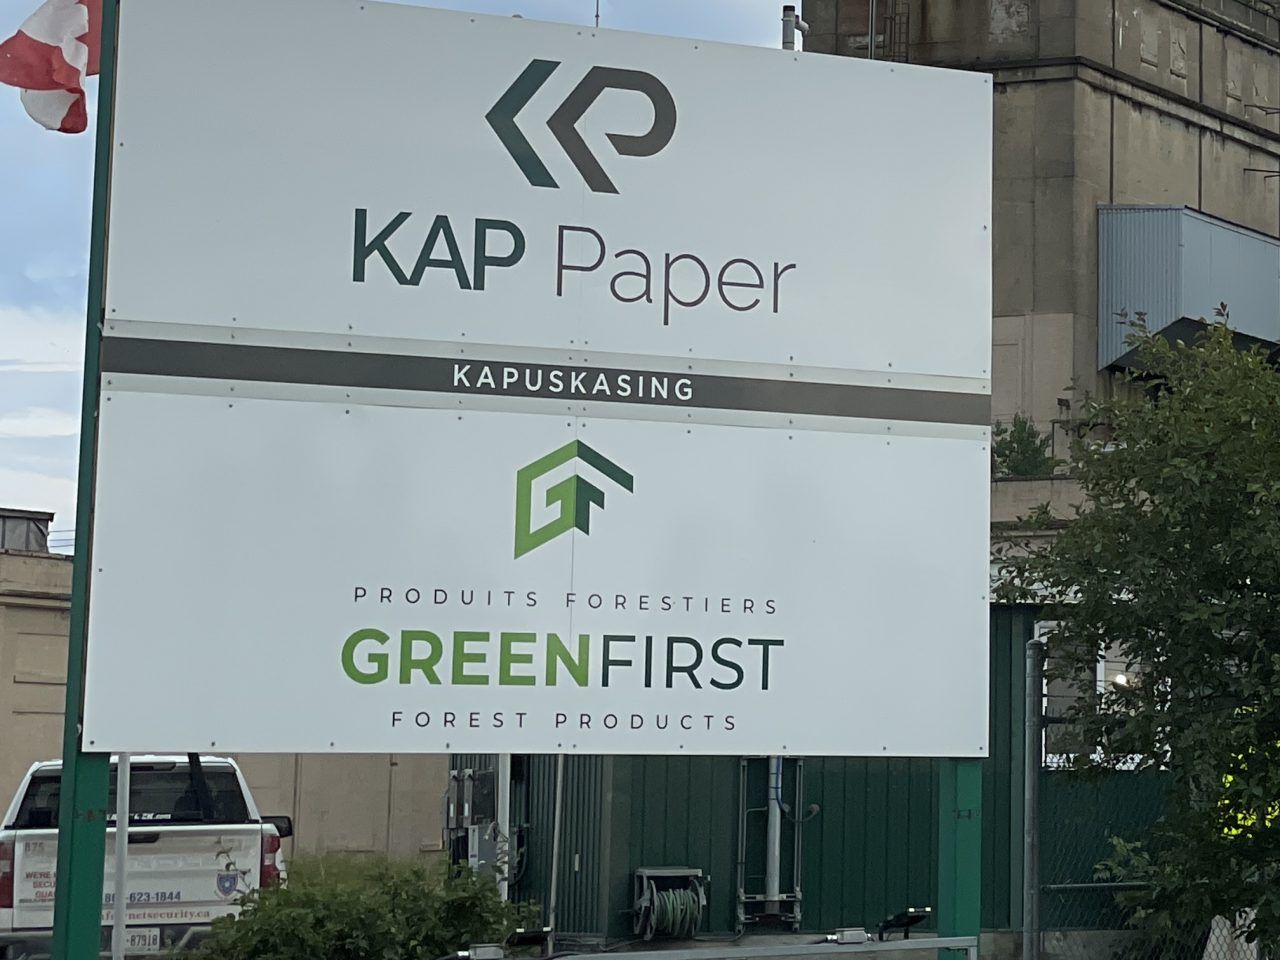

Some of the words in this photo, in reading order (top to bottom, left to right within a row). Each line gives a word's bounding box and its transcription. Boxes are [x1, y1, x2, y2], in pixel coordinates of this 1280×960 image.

[352, 208, 526, 291] KAP
[556, 224, 797, 326] Paper
[452, 363, 694, 401] KAPUSKASING
[354, 586, 539, 608] PRODUITS
[565, 592, 778, 615] FORESTIERS
[340, 627, 785, 691] GREENFIRST
[391, 710, 528, 730] FOREST
[554, 712, 737, 731] PRODUCTS
